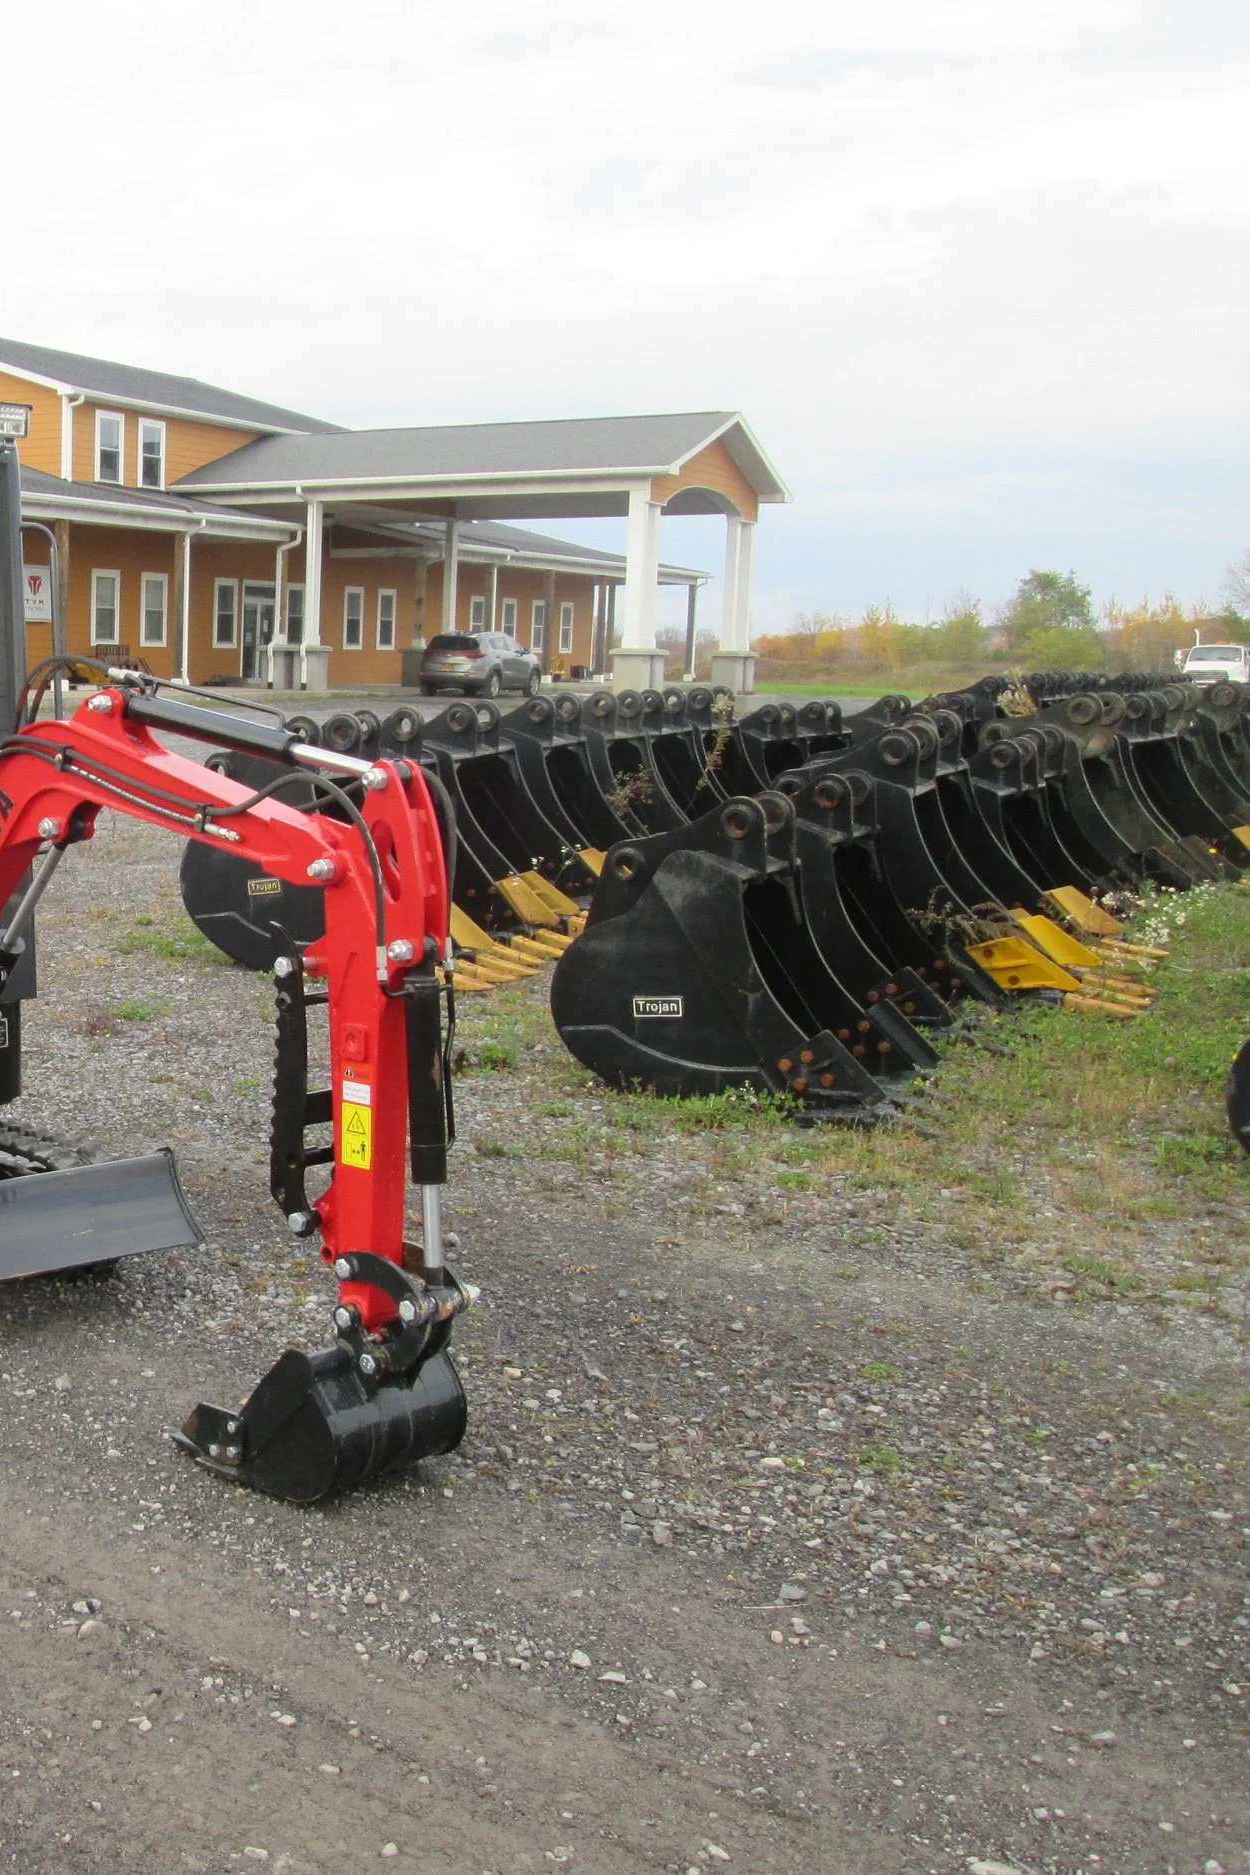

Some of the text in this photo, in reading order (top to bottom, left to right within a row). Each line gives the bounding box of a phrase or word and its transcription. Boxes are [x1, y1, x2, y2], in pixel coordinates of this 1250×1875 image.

[25, 598, 45, 606] TYM
[250, 882, 278, 892] Trojan
[636, 1000, 678, 1014] Trojan
